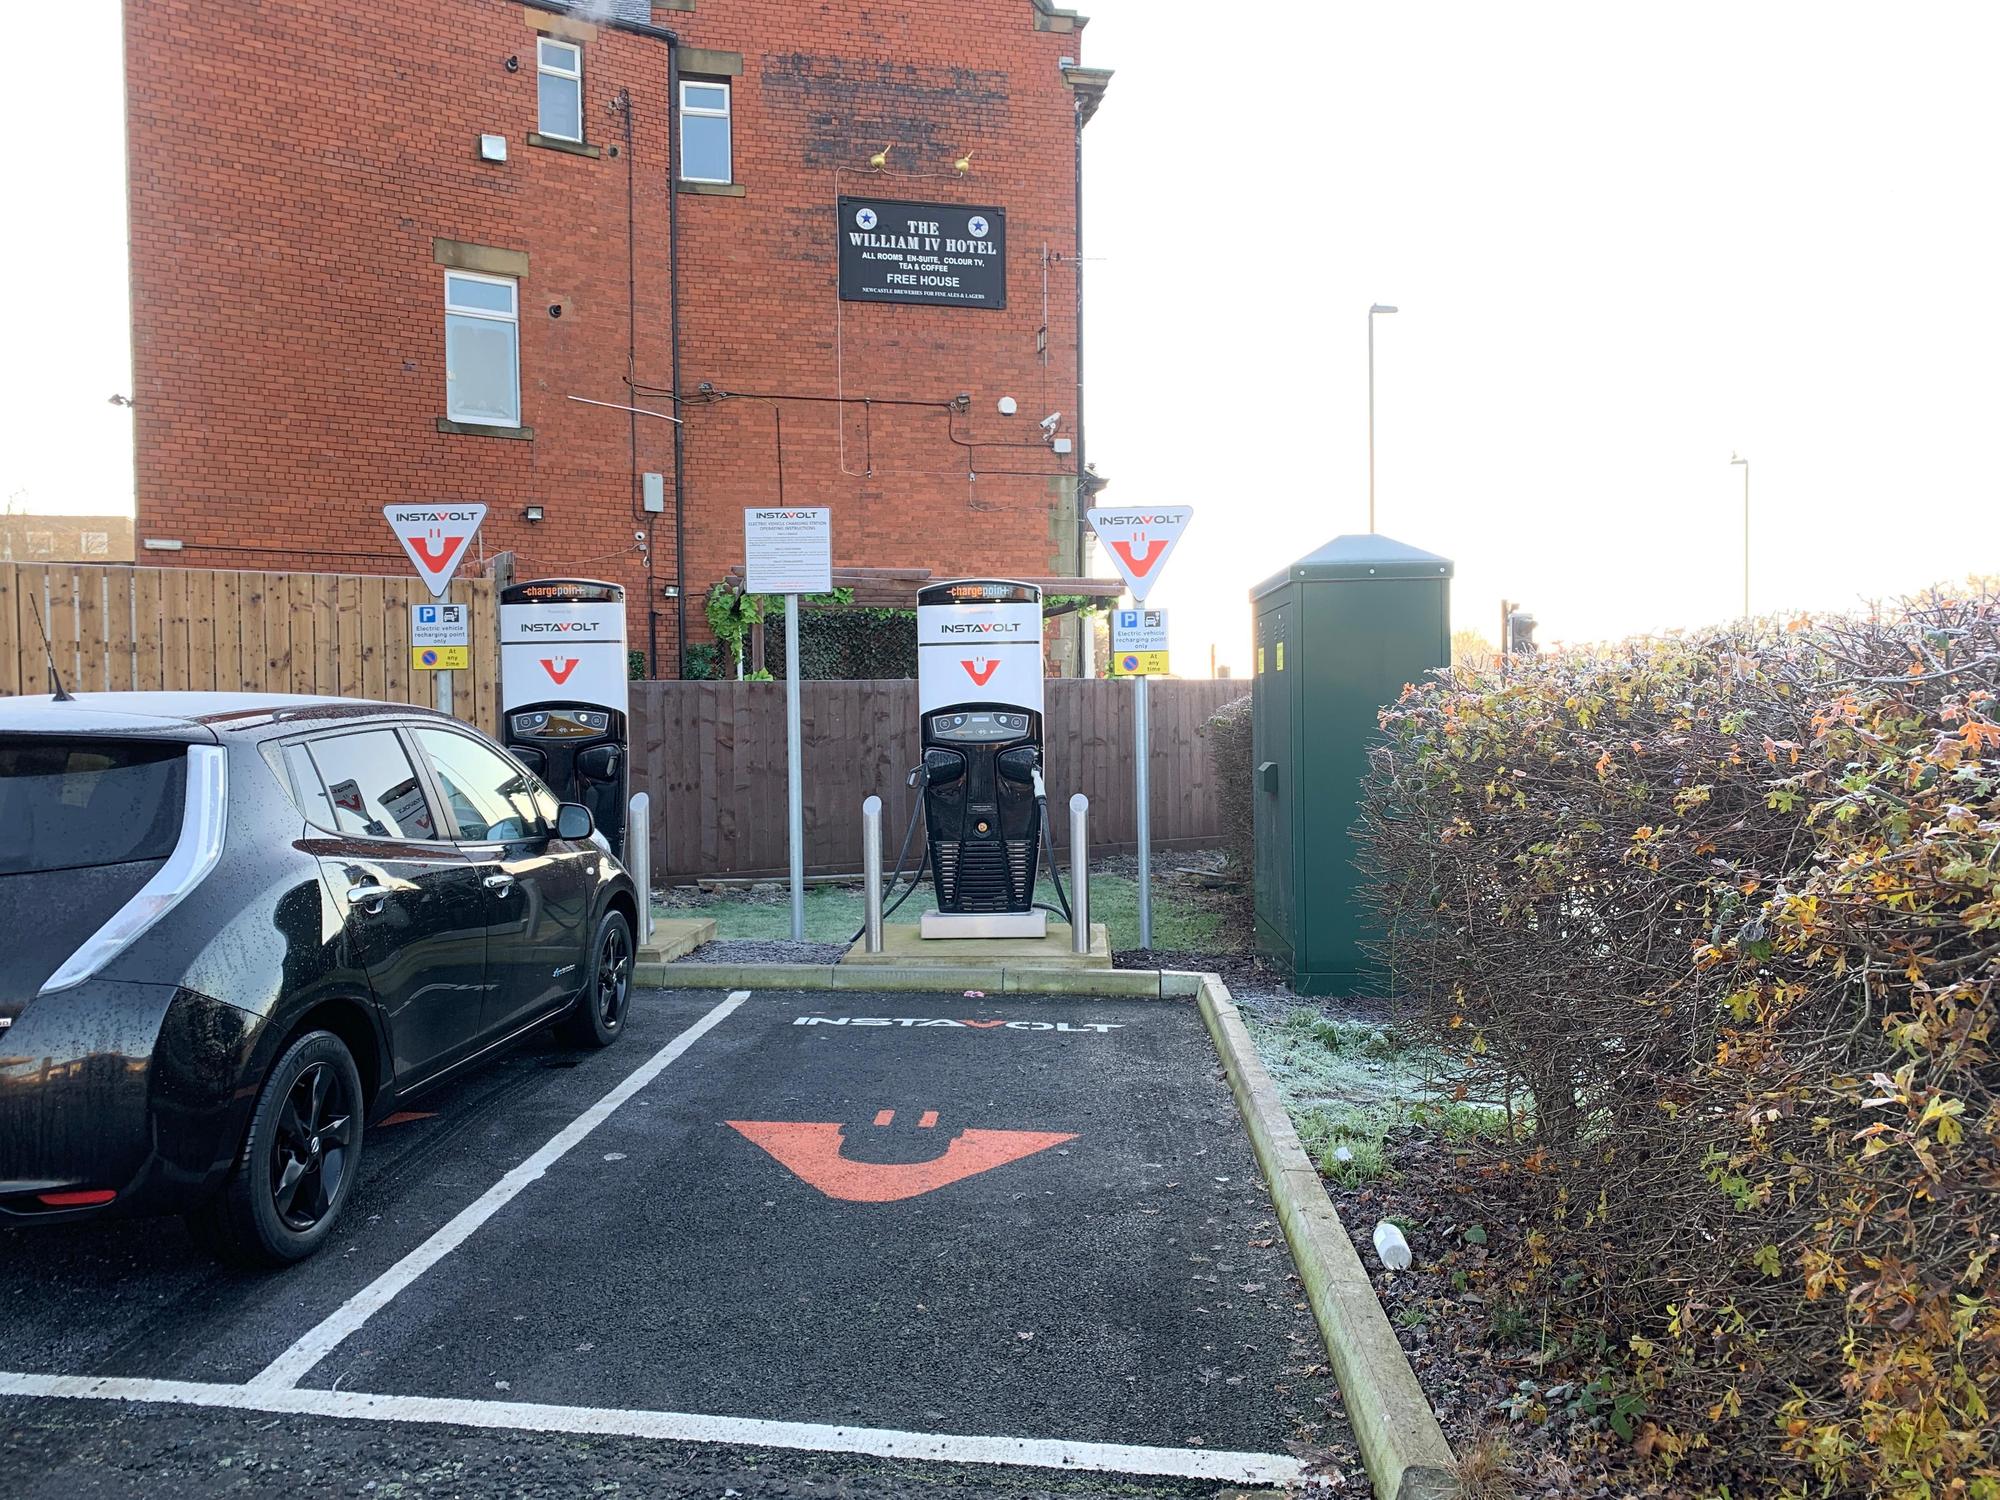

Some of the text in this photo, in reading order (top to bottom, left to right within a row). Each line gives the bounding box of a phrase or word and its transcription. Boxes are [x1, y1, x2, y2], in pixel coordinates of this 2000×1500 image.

[907, 220, 939, 235] THE
[849, 232, 997, 255] WILLIAM IV HOTEL
[877, 253, 903, 261] ROOMS
[907, 255, 940, 264] EN-SUITE,
[944, 257, 972, 266] COLOUR
[974, 259, 985, 267] TV,
[899, 262, 913, 270] TEA
[921, 264, 948, 272] COFFEE
[887, 274, 960, 287] FREE HOUSE
[396, 511, 478, 522] INSTAVOLT
[756, 511, 818, 519] INSTAVOLT
[1099, 514, 1183, 525] INSTAVOLT
[422, 608, 434, 622] P
[1124, 613, 1136, 627] P
[521, 622, 600, 632] INSTAVOLT
[941, 623, 1021, 633] INSTAVOLT
[792, 1016, 1127, 1033] INSTAVOLT
